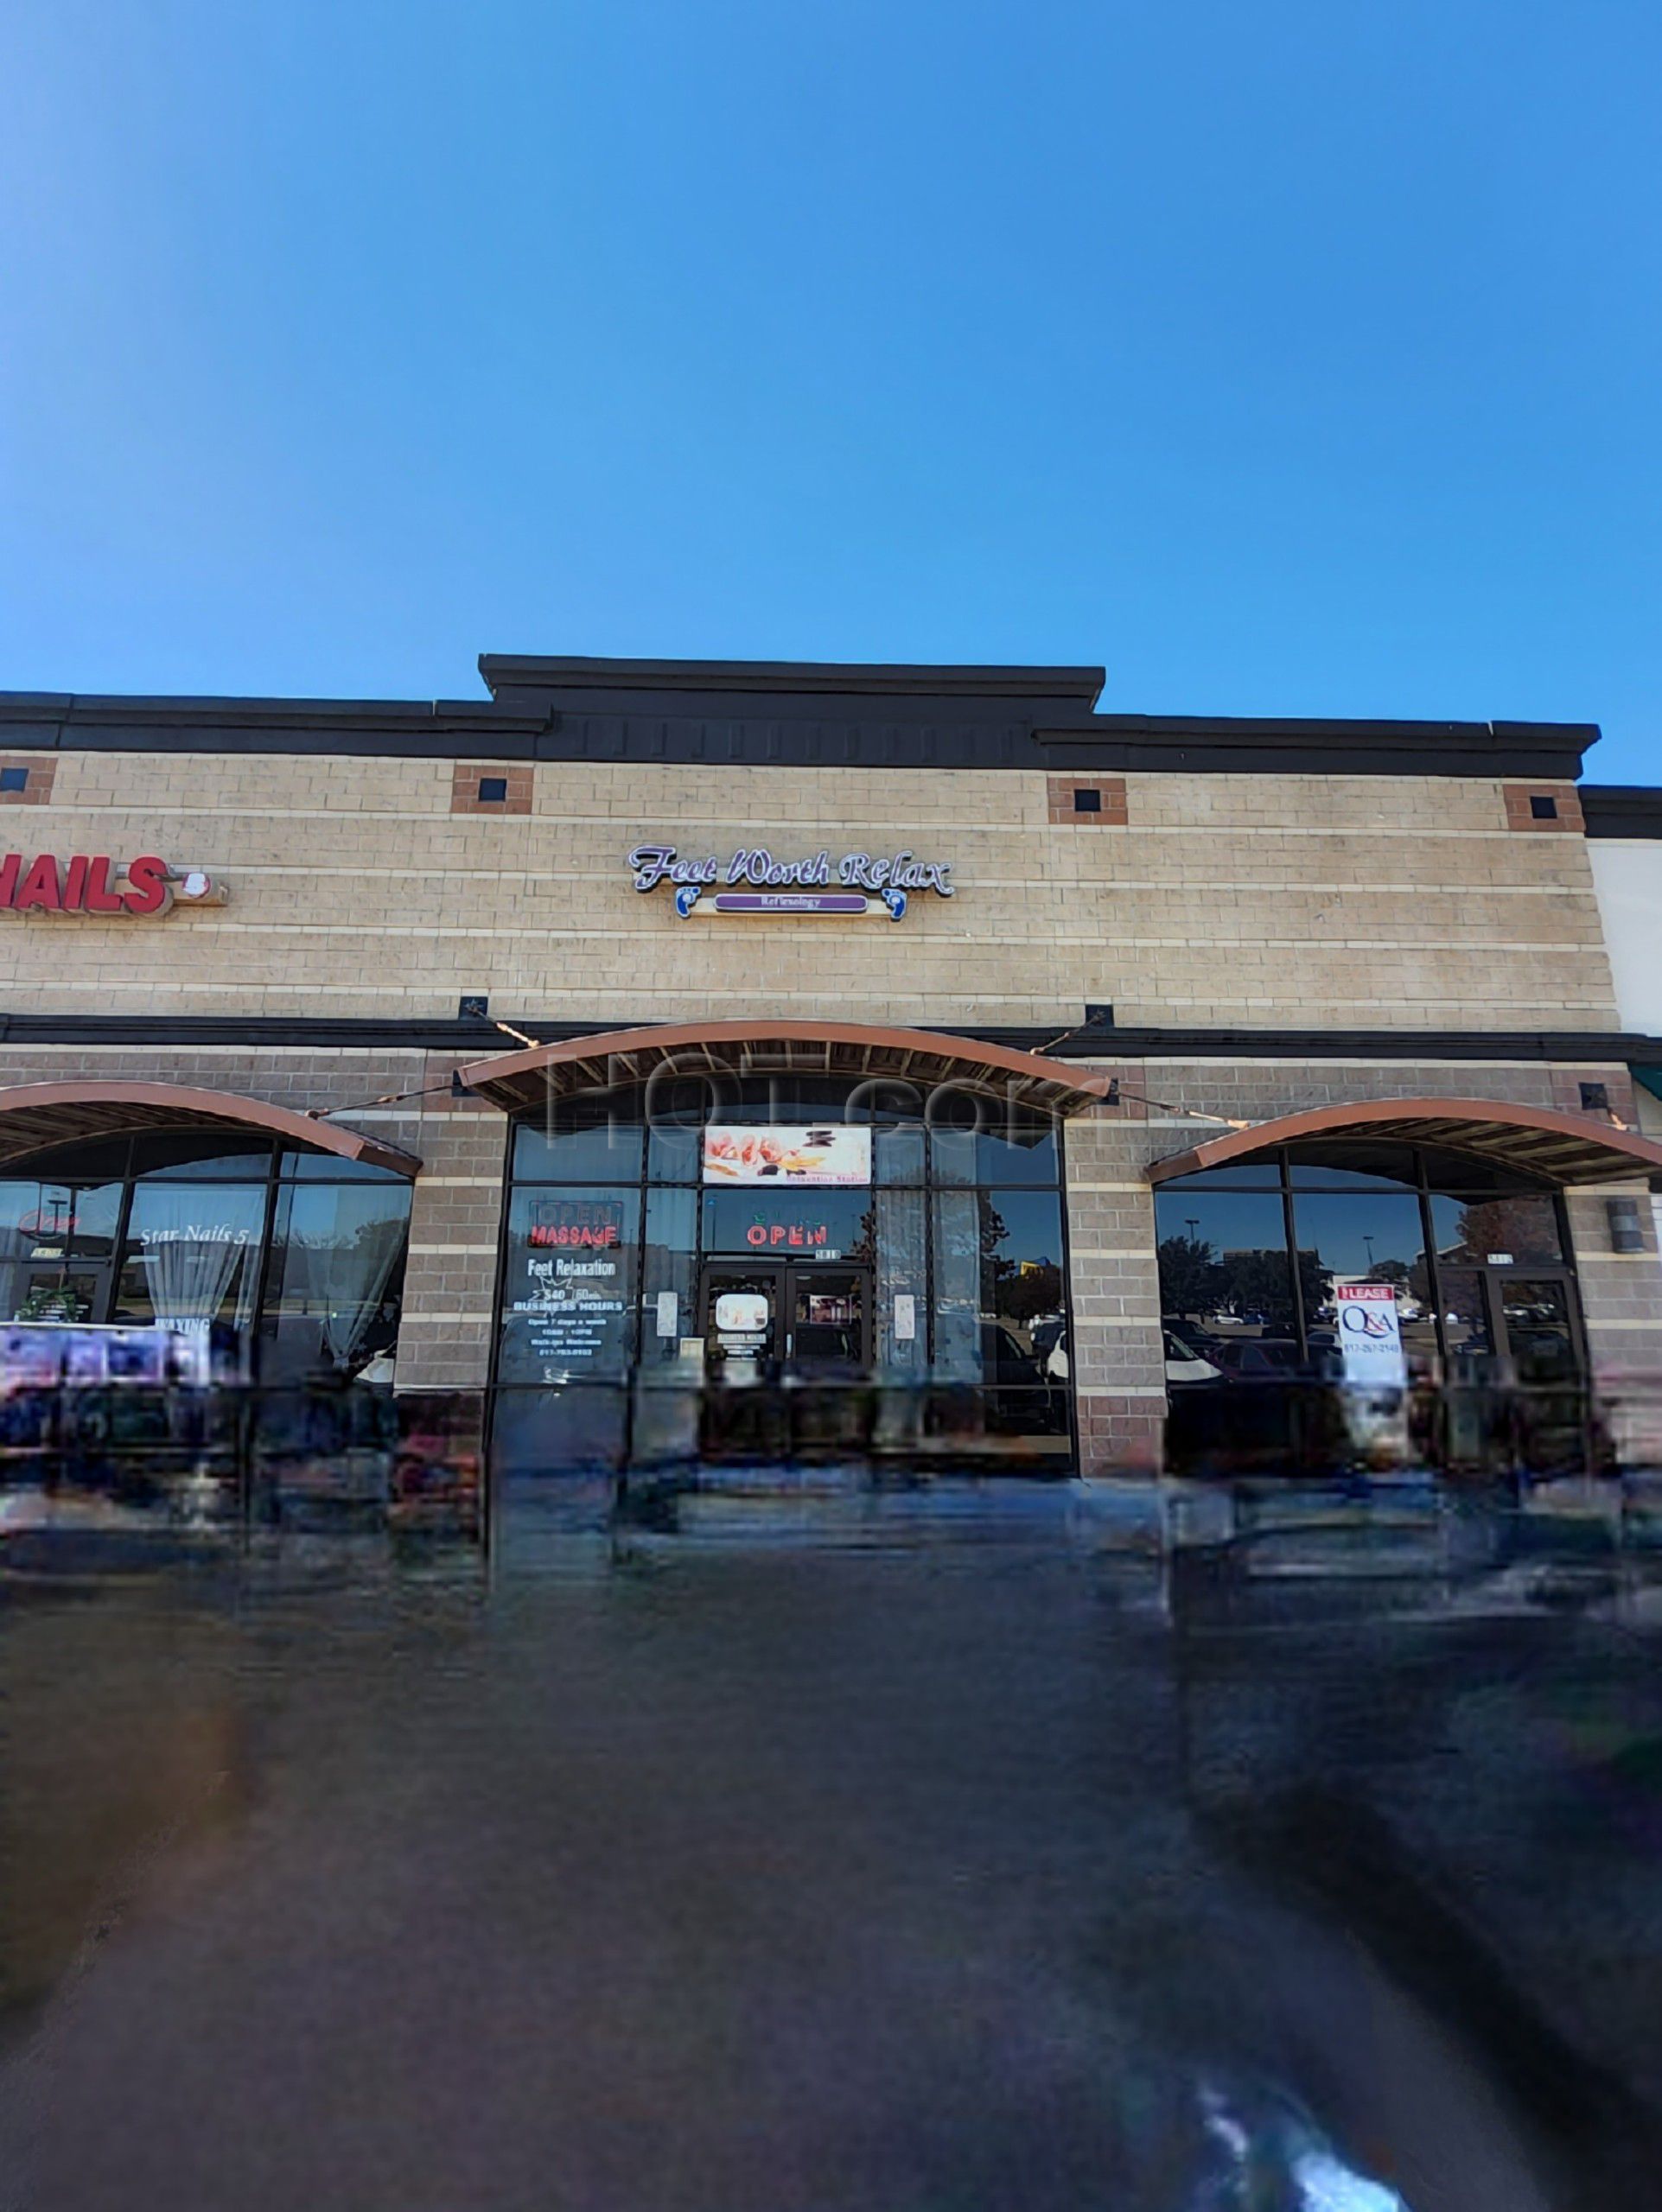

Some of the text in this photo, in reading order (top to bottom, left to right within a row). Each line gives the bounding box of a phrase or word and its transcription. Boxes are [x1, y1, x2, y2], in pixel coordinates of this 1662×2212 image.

[628, 846, 955, 895] Feet Worth Relax
[761, 896, 821, 908] Reflexology
[538, 1205, 613, 1225] OPEN
[140, 1224, 249, 1246] Star Nails 5
[531, 1225, 617, 1245] MASSAGE
[747, 1225, 827, 1245] OPEN
[527, 1257, 616, 1277] Feet Relaxation
[1349, 1287, 1390, 1300] LEASE
[513, 1301, 623, 1311] BUSINESS HOURS
